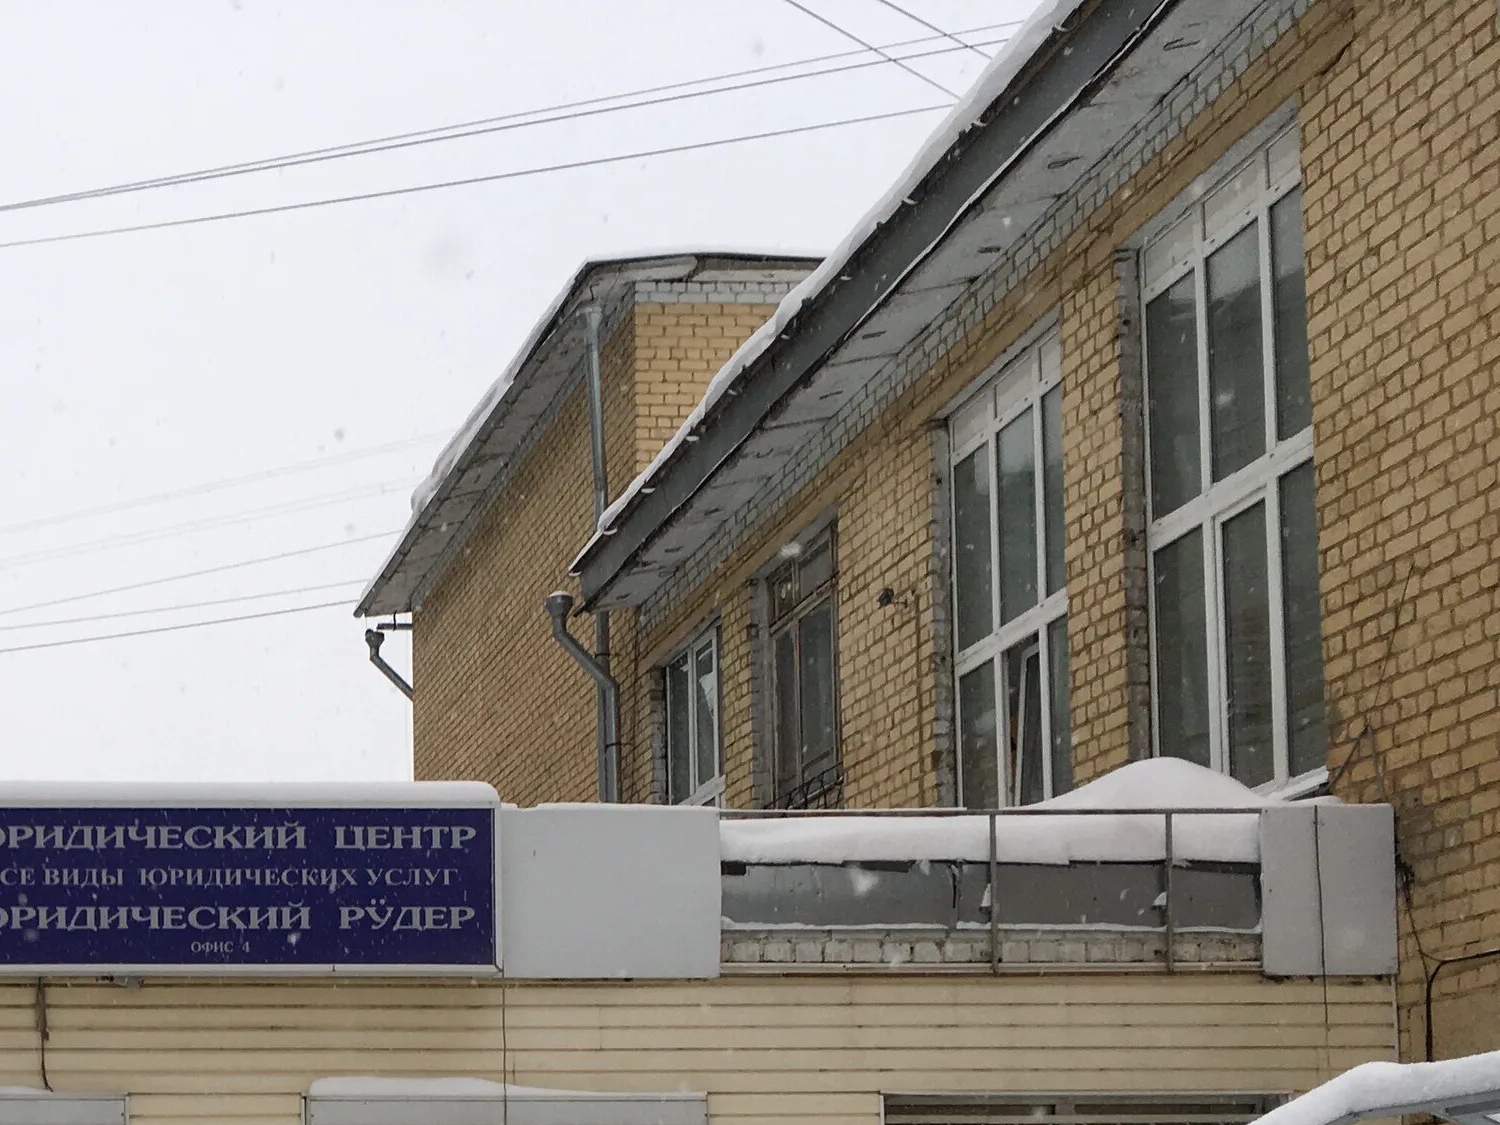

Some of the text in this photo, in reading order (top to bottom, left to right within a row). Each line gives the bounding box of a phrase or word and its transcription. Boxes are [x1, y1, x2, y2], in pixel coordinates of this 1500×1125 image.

[334, 826, 477, 853] ЦЕНТР
[42, 868, 124, 887] ВИДЫ
[138, 867, 358, 888] ЮРИДИЧЕСКИХ
[366, 868, 459, 888] УСЛУГ
[190, 940, 251, 954] ОФИС 4
